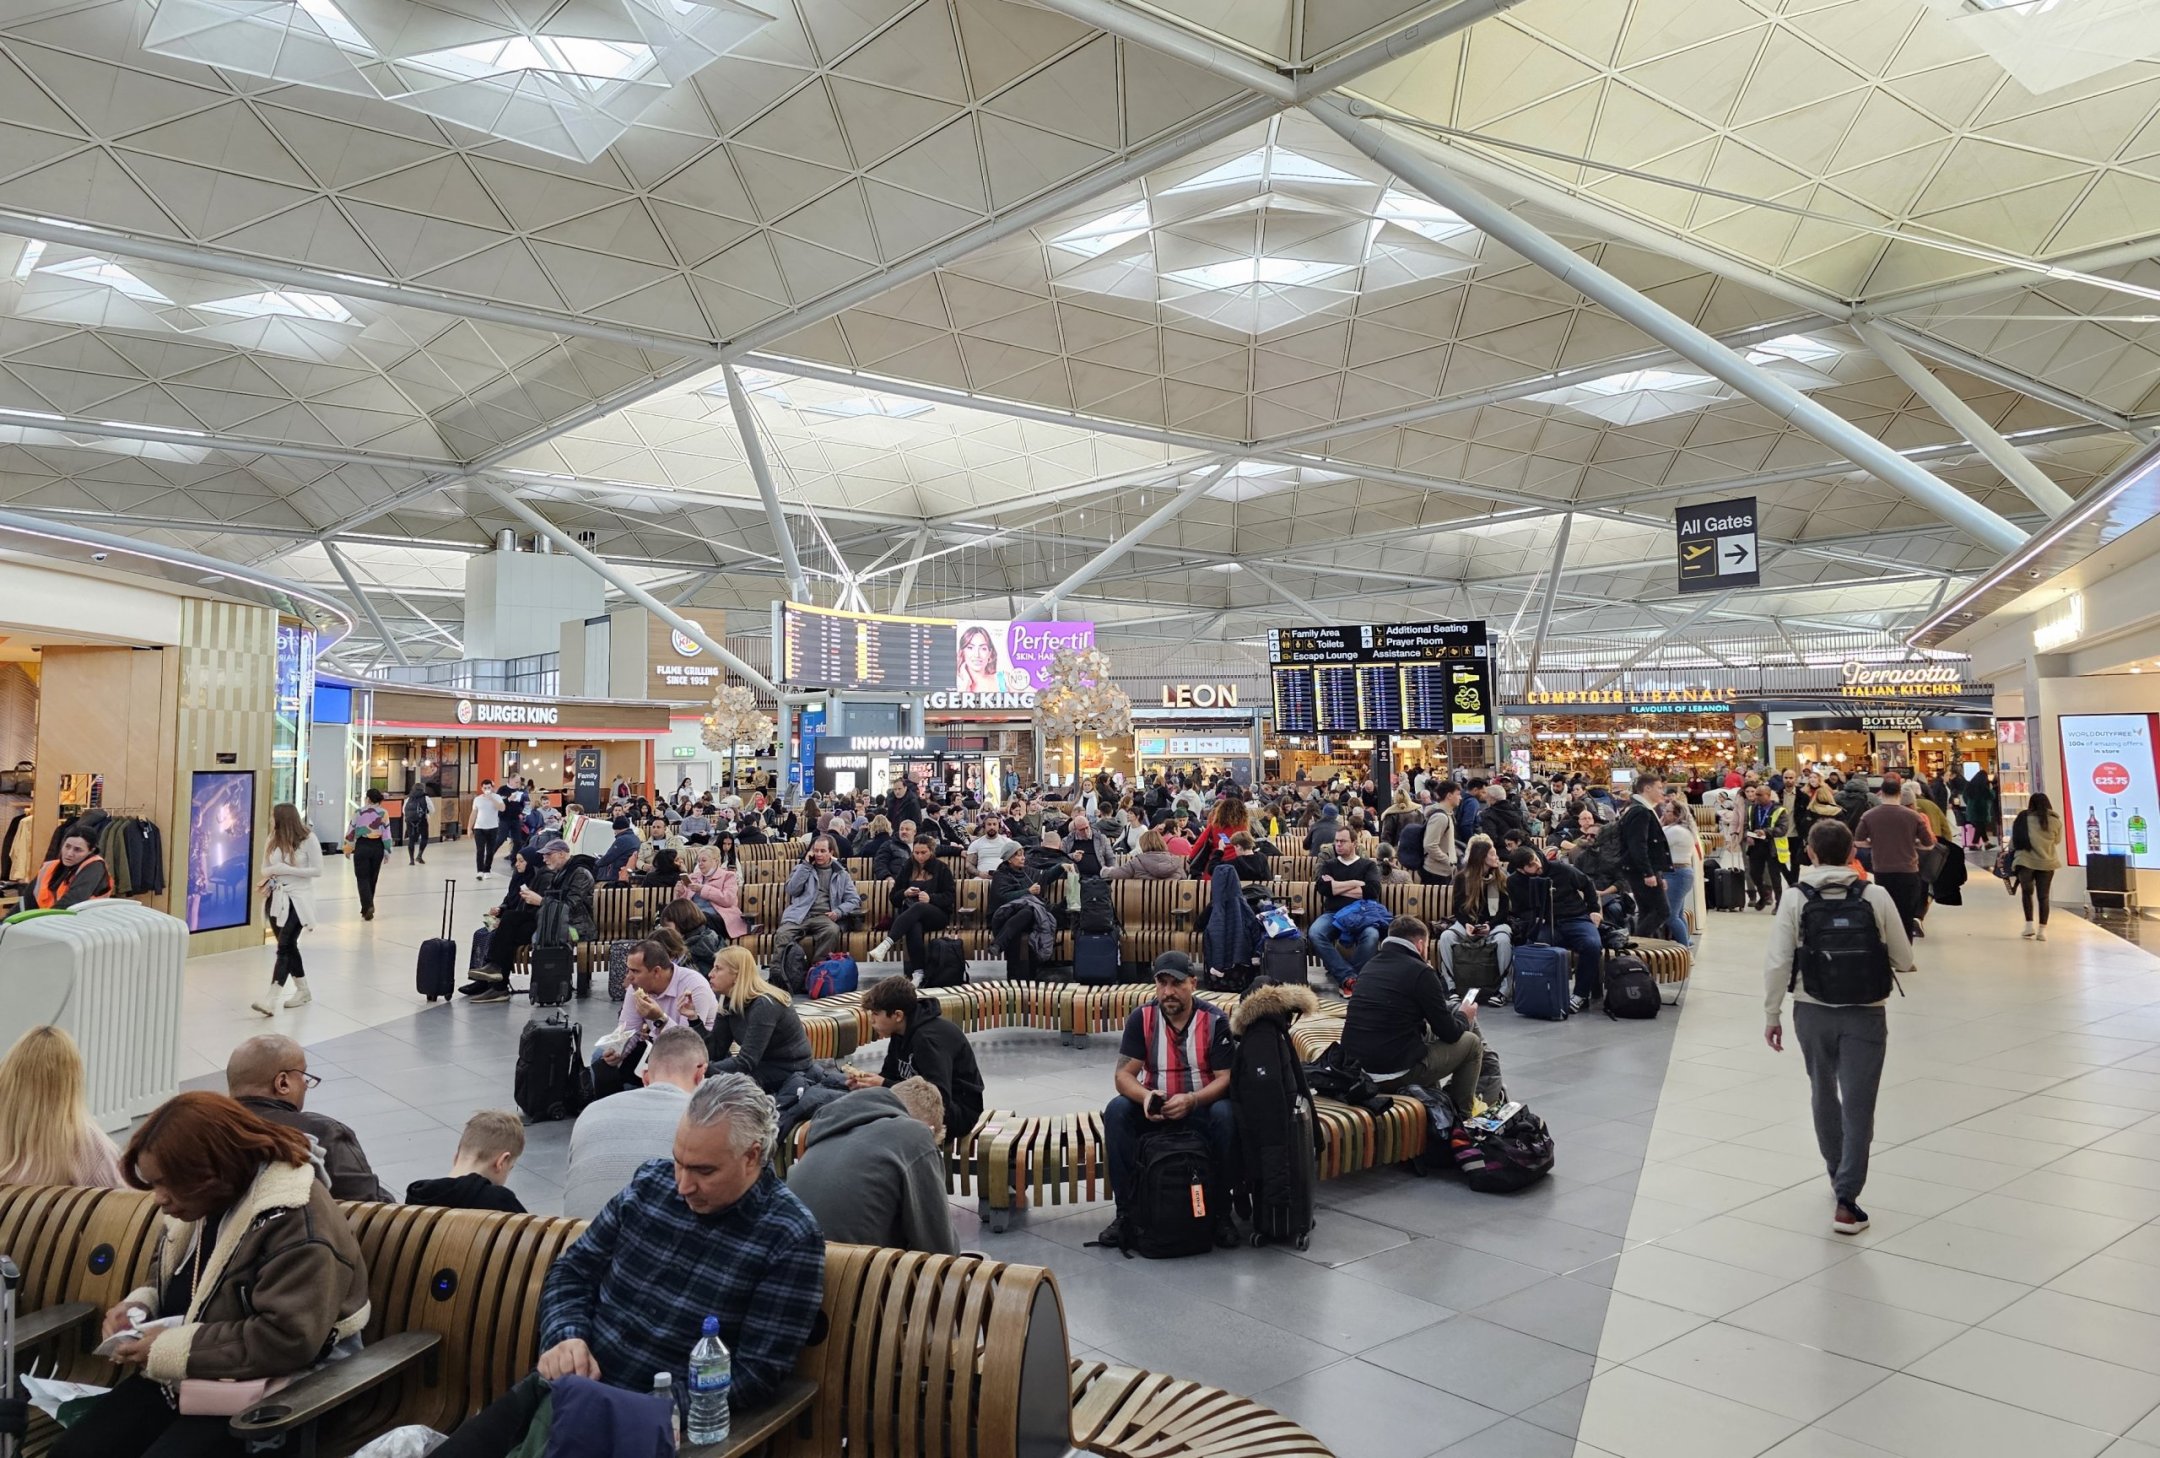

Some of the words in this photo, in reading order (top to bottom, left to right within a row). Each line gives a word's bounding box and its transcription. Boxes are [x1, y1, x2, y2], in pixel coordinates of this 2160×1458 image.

[1680, 519, 1700, 535] All
[1704, 515, 1753, 532] Gates
[1291, 629, 1319, 638] Family
[1320, 629, 1340, 637] Area
[1386, 625, 1431, 635] Additional
[1432, 624, 1468, 633] Seating
[1011, 625, 1089, 656] Perfectil
[1316, 640, 1344, 648] Toilets
[1386, 638, 1415, 647] Prayer
[1416, 637, 1443, 645] Room
[1293, 652, 1324, 661] Escape
[1325, 651, 1358, 660] Lounge
[1372, 649, 1421, 658] Assistance
[656, 665, 682, 675] FLAME
[683, 667, 719, 676] GRILLING
[1842, 661, 1960, 684] Terracotta
[666, 675, 688, 685] SINCE
[690, 677, 709, 686] 1954
[1842, 686, 1895, 696] ITALIAN
[1900, 684, 1961, 695] KITCHEN
[978, 691, 1036, 709] KING
[1162, 684, 1238, 708] LEON
[1527, 691, 1623, 704] COMPTOIR
[1629, 688, 1736, 704] LIBANAIS
[477, 704, 527, 723] BURGER
[527, 706, 558, 724] KING
[1674, 705, 1687, 713] OF
[1688, 704, 1730, 712] LEBANON
[1862, 717, 1922, 725] BOTTEGA
[851, 736, 925, 750] INMOTION
[577, 773, 598, 782] Family
